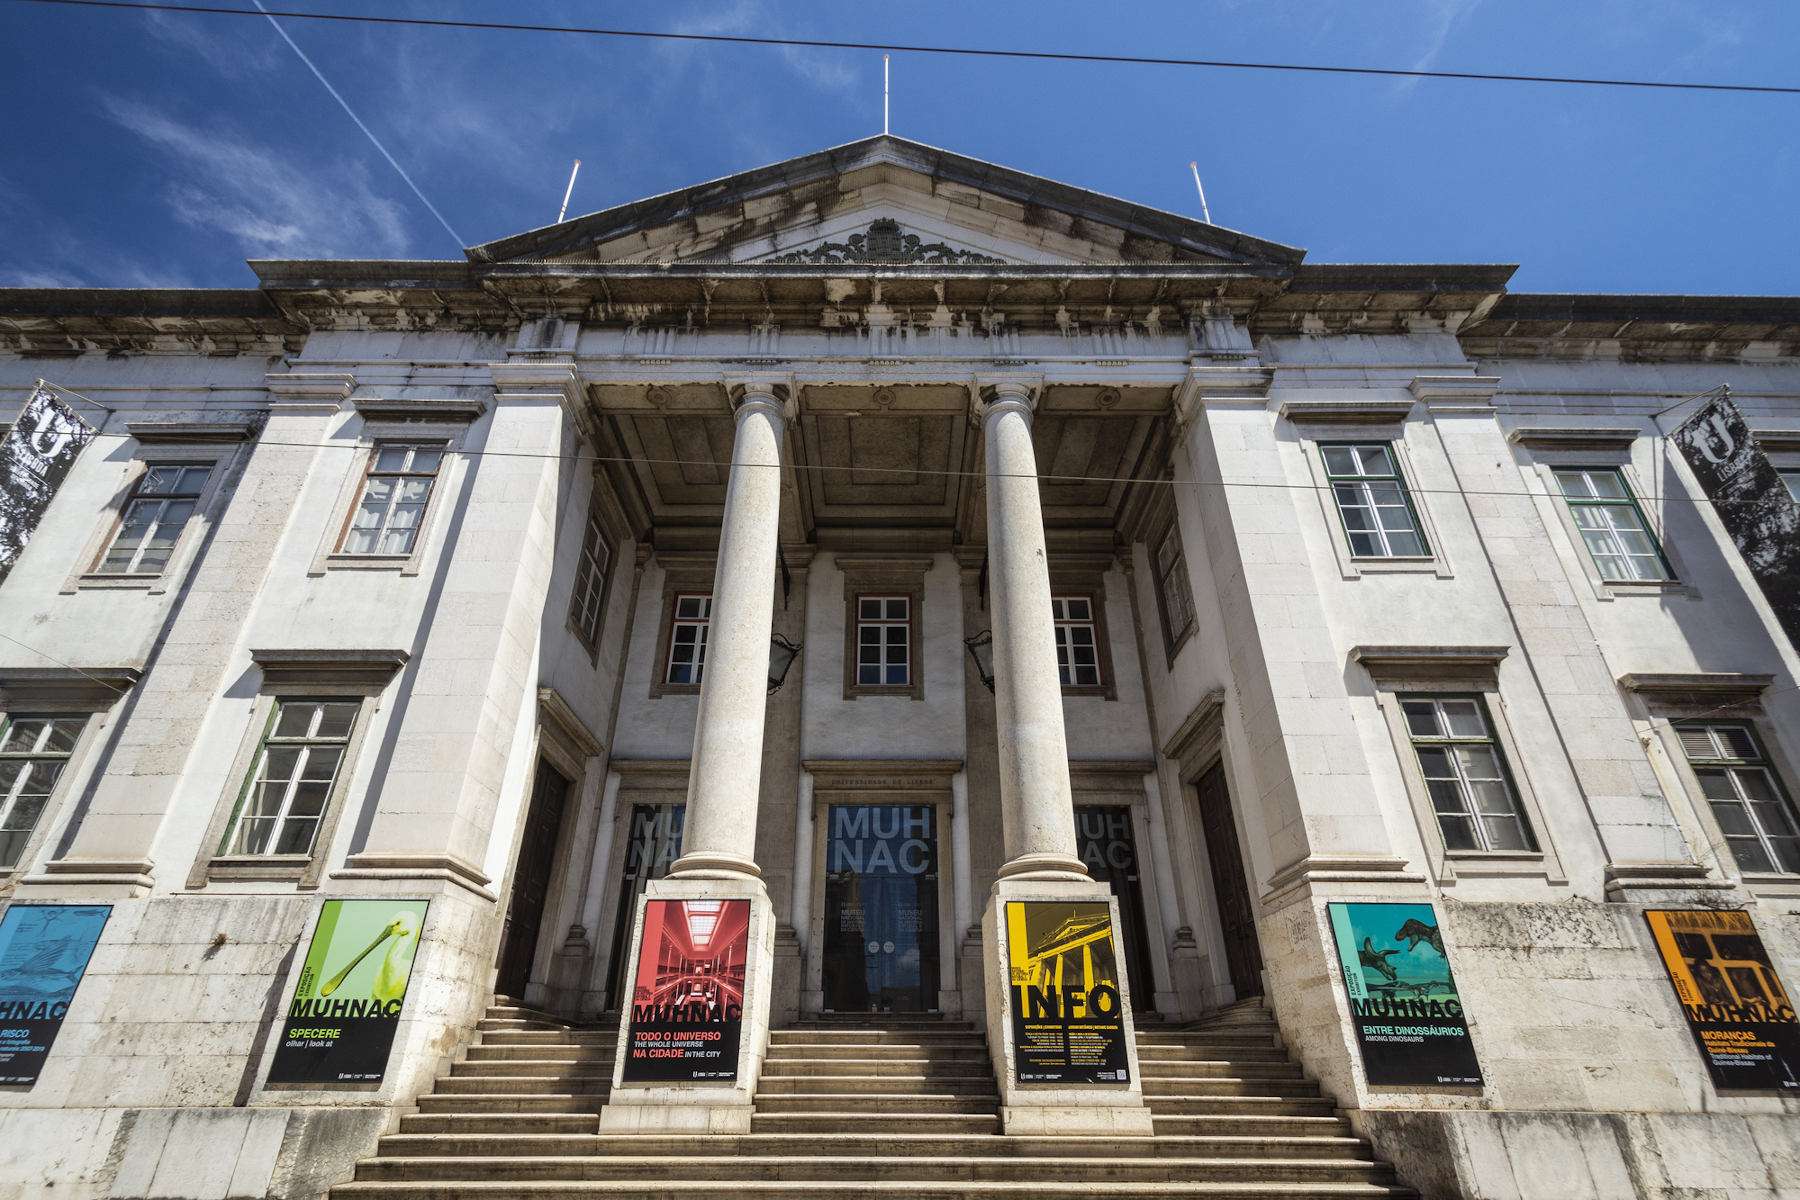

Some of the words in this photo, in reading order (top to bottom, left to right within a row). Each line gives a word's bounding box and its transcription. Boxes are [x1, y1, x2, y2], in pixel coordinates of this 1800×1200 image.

[634, 812, 685, 839] MU
[834, 807, 930, 839] MUH
[629, 839, 679, 868] NA
[833, 839, 930, 875] NAC
[1083, 840, 1132, 869] AC
[0, 1000, 67, 1020] HNAC
[290, 998, 402, 1018] MUHNAC
[1011, 985, 1121, 1019] INFO
[1352, 998, 1464, 1018] MUHNAC
[632, 1004, 742, 1023] MUHNAC
[1684, 1004, 1797, 1024] MUHNAC
[289, 1028, 342, 1039] SPECERE
[635, 1031, 662, 1041] TODO
[663, 1031, 672, 1041] O
[673, 1031, 721, 1041] UNIVERSO
[1362, 1026, 1394, 1035] ENTRE
[1395, 1025, 1465, 1036] DINOSSÁURIOS
[633, 1049, 647, 1058] NA
[648, 1049, 685, 1058] CIDADE
